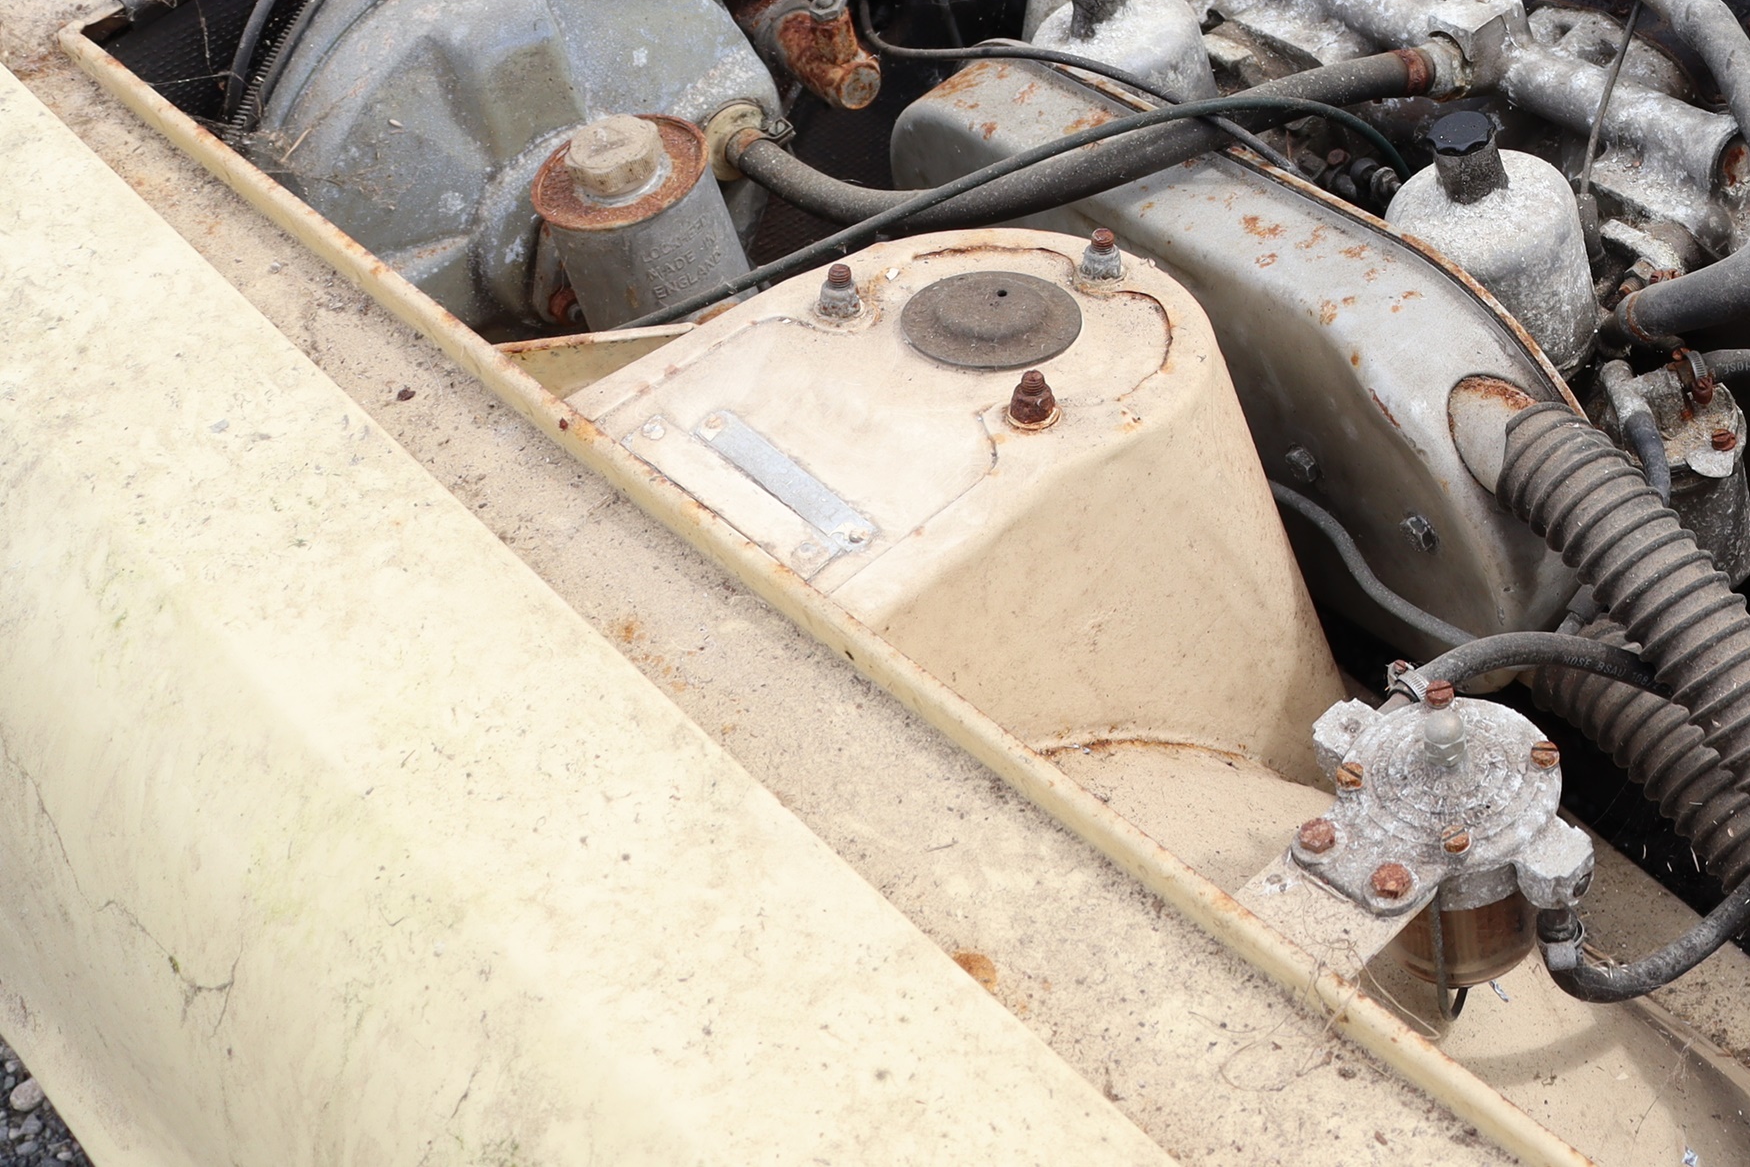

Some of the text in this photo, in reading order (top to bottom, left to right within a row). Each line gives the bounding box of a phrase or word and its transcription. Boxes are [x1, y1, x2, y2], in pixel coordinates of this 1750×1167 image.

[642, 214, 707, 263] LOCKHEED
[647, 250, 697, 282] MADE
[653, 250, 721, 300] ENGLAND
[1563, 655, 1593, 668] HOSE
[1596, 662, 1627, 679] BSAU
